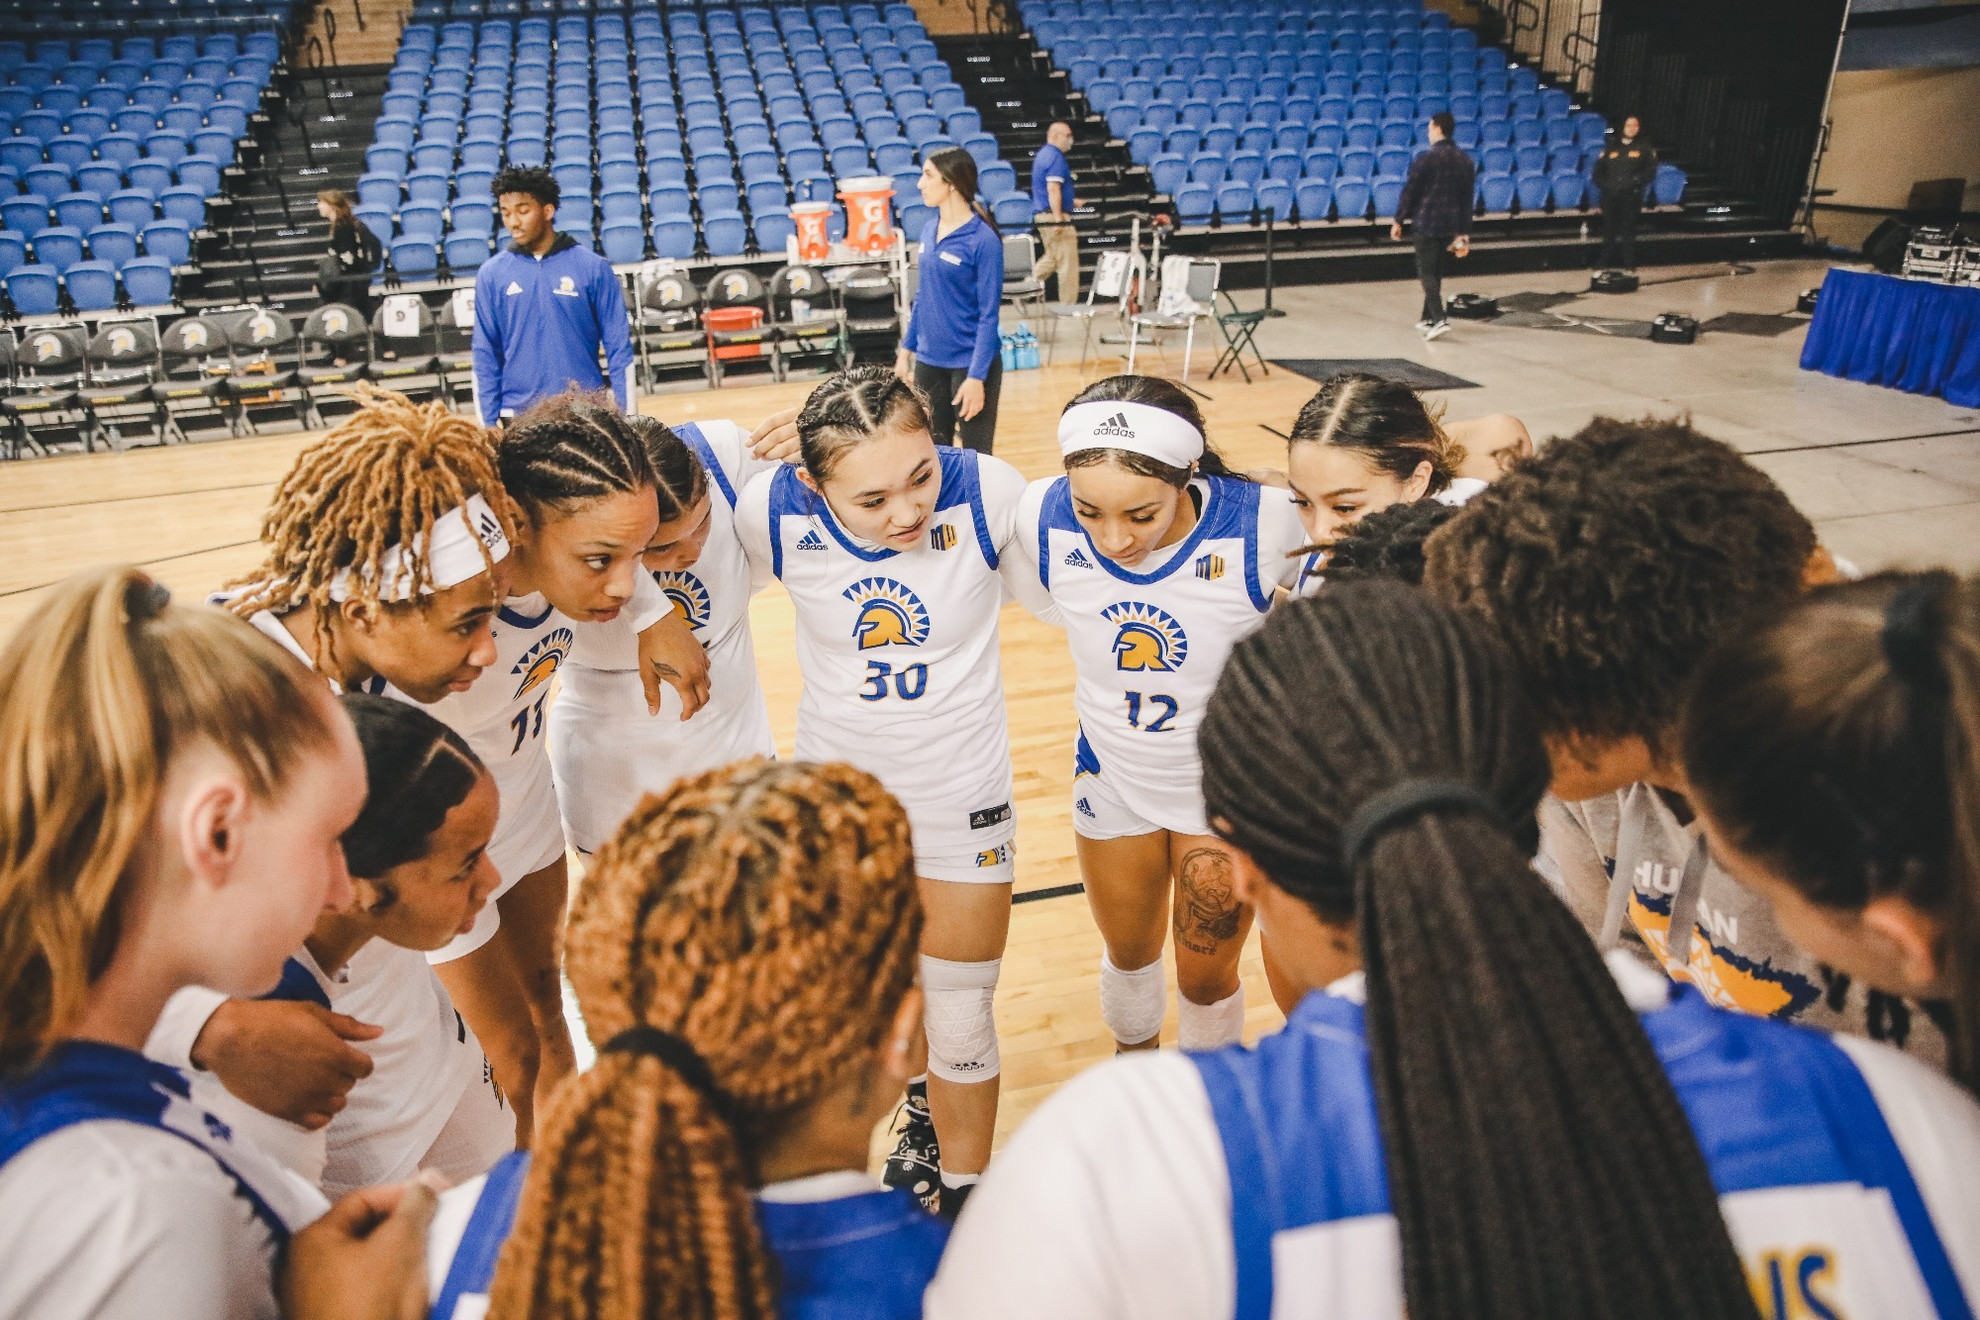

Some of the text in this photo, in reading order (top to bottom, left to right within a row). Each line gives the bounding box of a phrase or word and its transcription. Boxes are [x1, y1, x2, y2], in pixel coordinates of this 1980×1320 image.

[863, 201, 883, 222] G
[1093, 426, 1136, 439] adidas
[796, 542, 829, 551] adidas
[1064, 557, 1094, 570] adidas
[858, 659, 929, 702] 30
[1123, 690, 1179, 732] 12
[1633, 860, 1739, 946] HUAN
